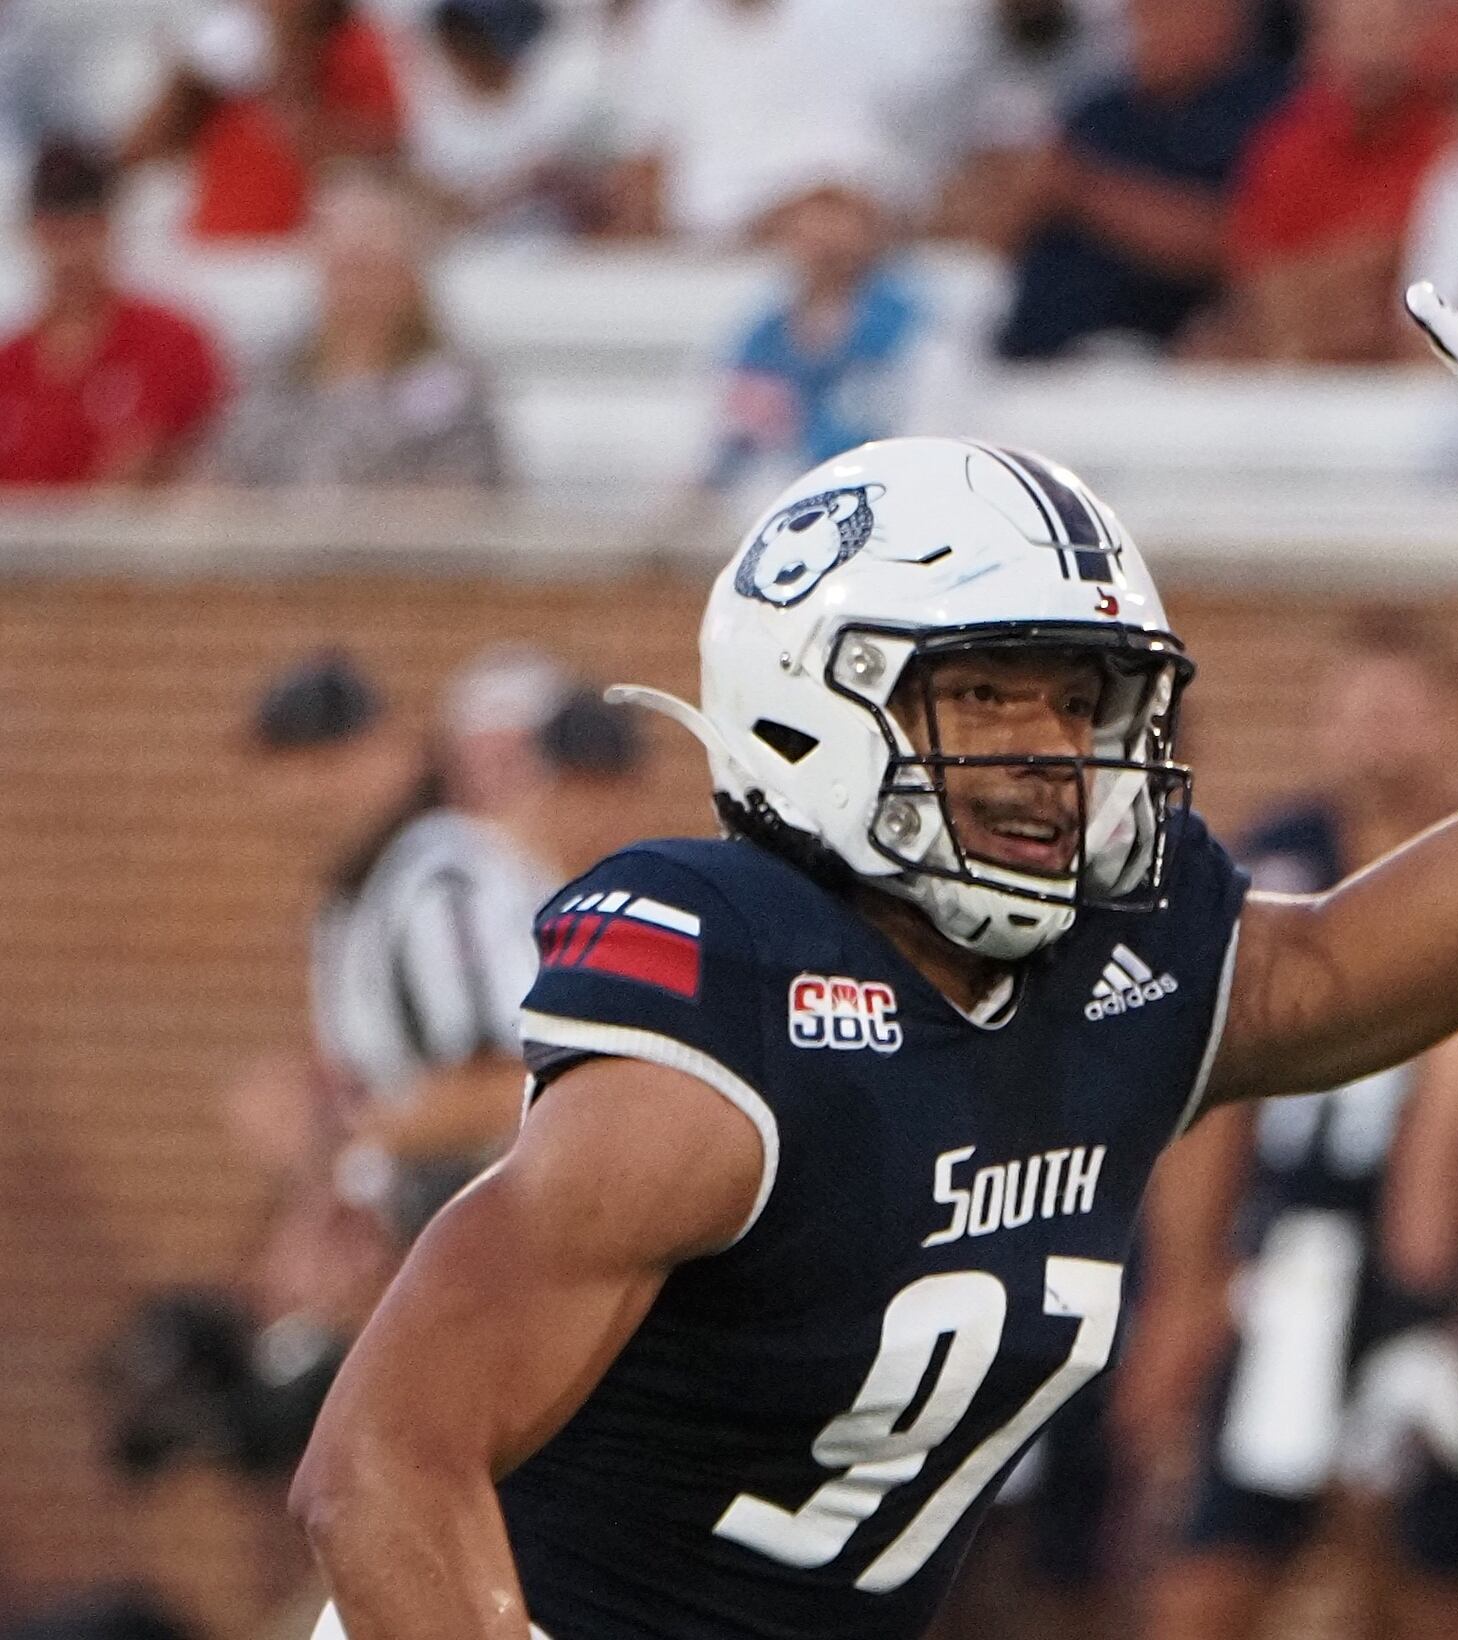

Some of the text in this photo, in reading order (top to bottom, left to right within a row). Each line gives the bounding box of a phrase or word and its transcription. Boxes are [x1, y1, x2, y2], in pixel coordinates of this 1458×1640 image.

[789, 974, 903, 1053] SBC
[1083, 973, 1179, 1022] adidas
[920, 1145, 1107, 1249] SOUTH
[711, 1255, 1125, 1595] 97
